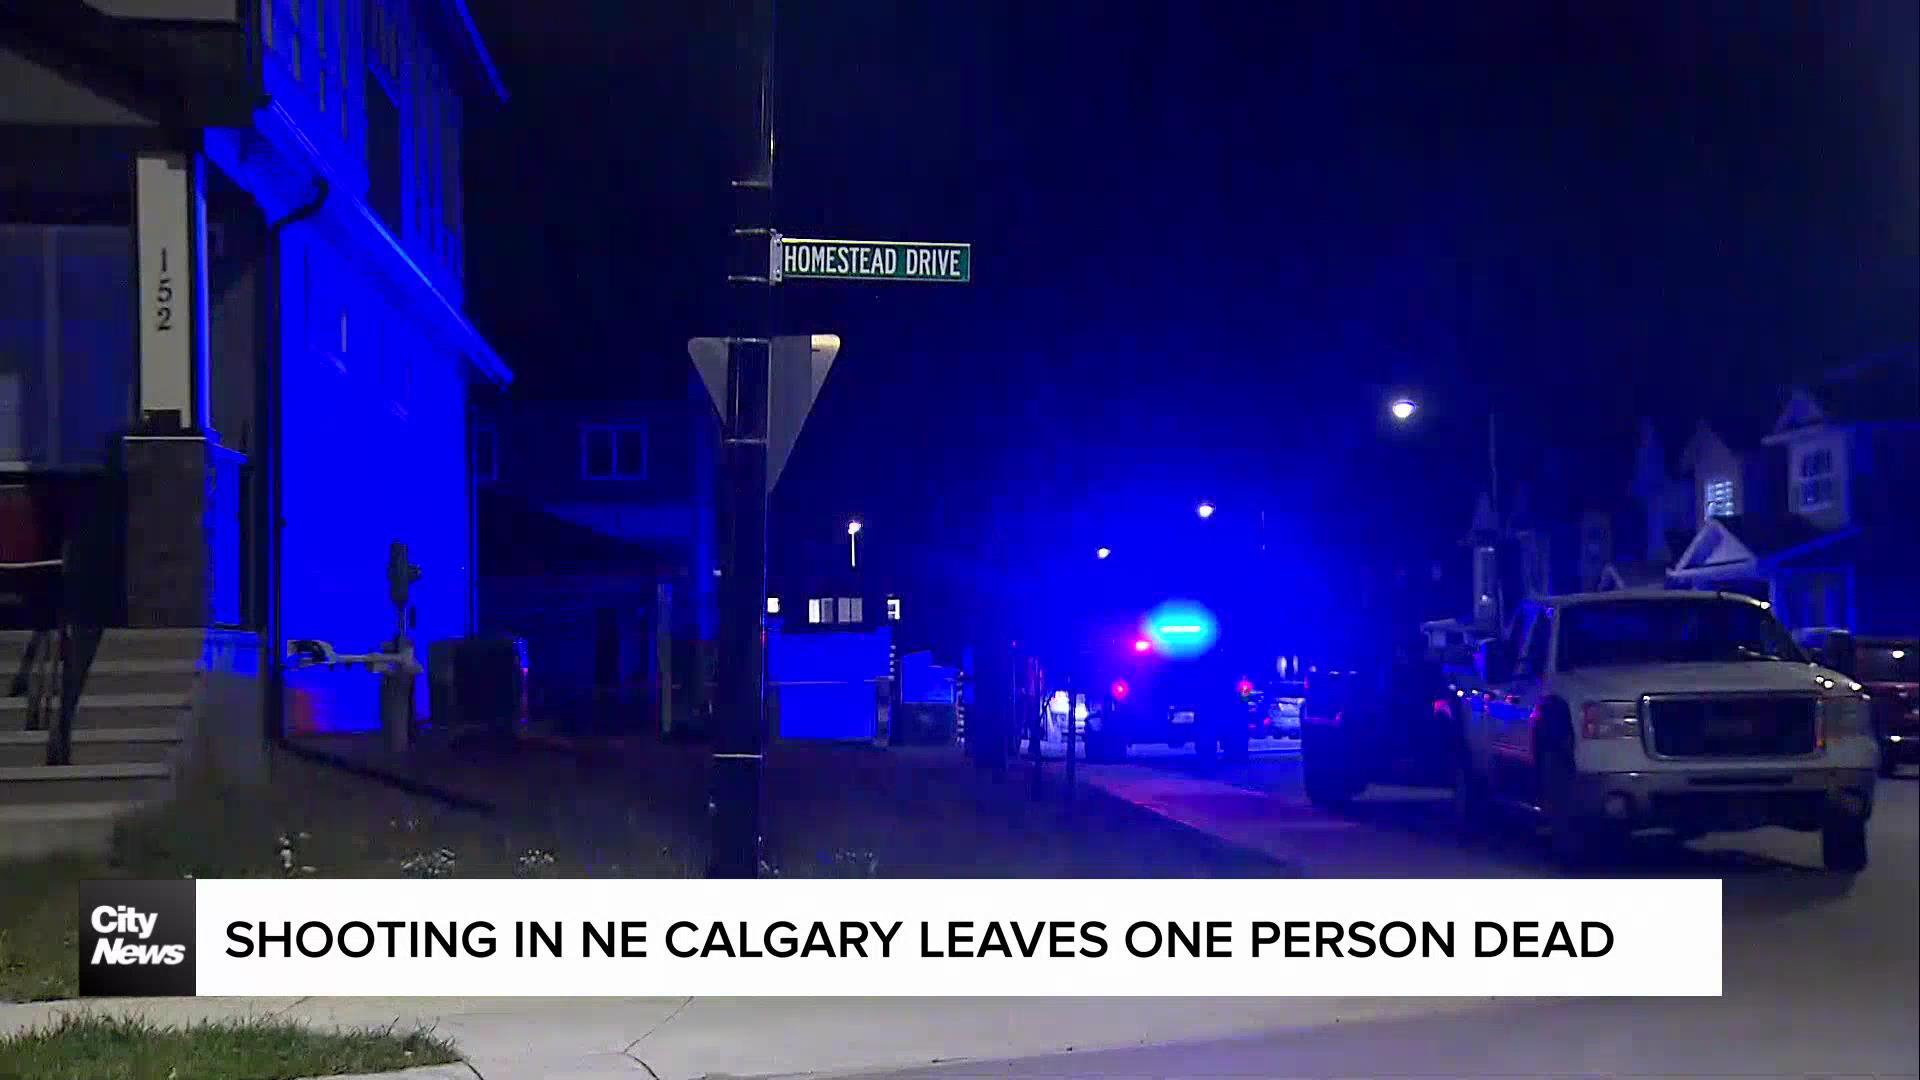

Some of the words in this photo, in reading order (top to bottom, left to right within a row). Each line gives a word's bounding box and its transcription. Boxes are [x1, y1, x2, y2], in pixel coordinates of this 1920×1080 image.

[784, 245, 897, 275] HOMESTEAD
[906, 249, 961, 276] DRIVE
[157, 248, 172, 331] 152
